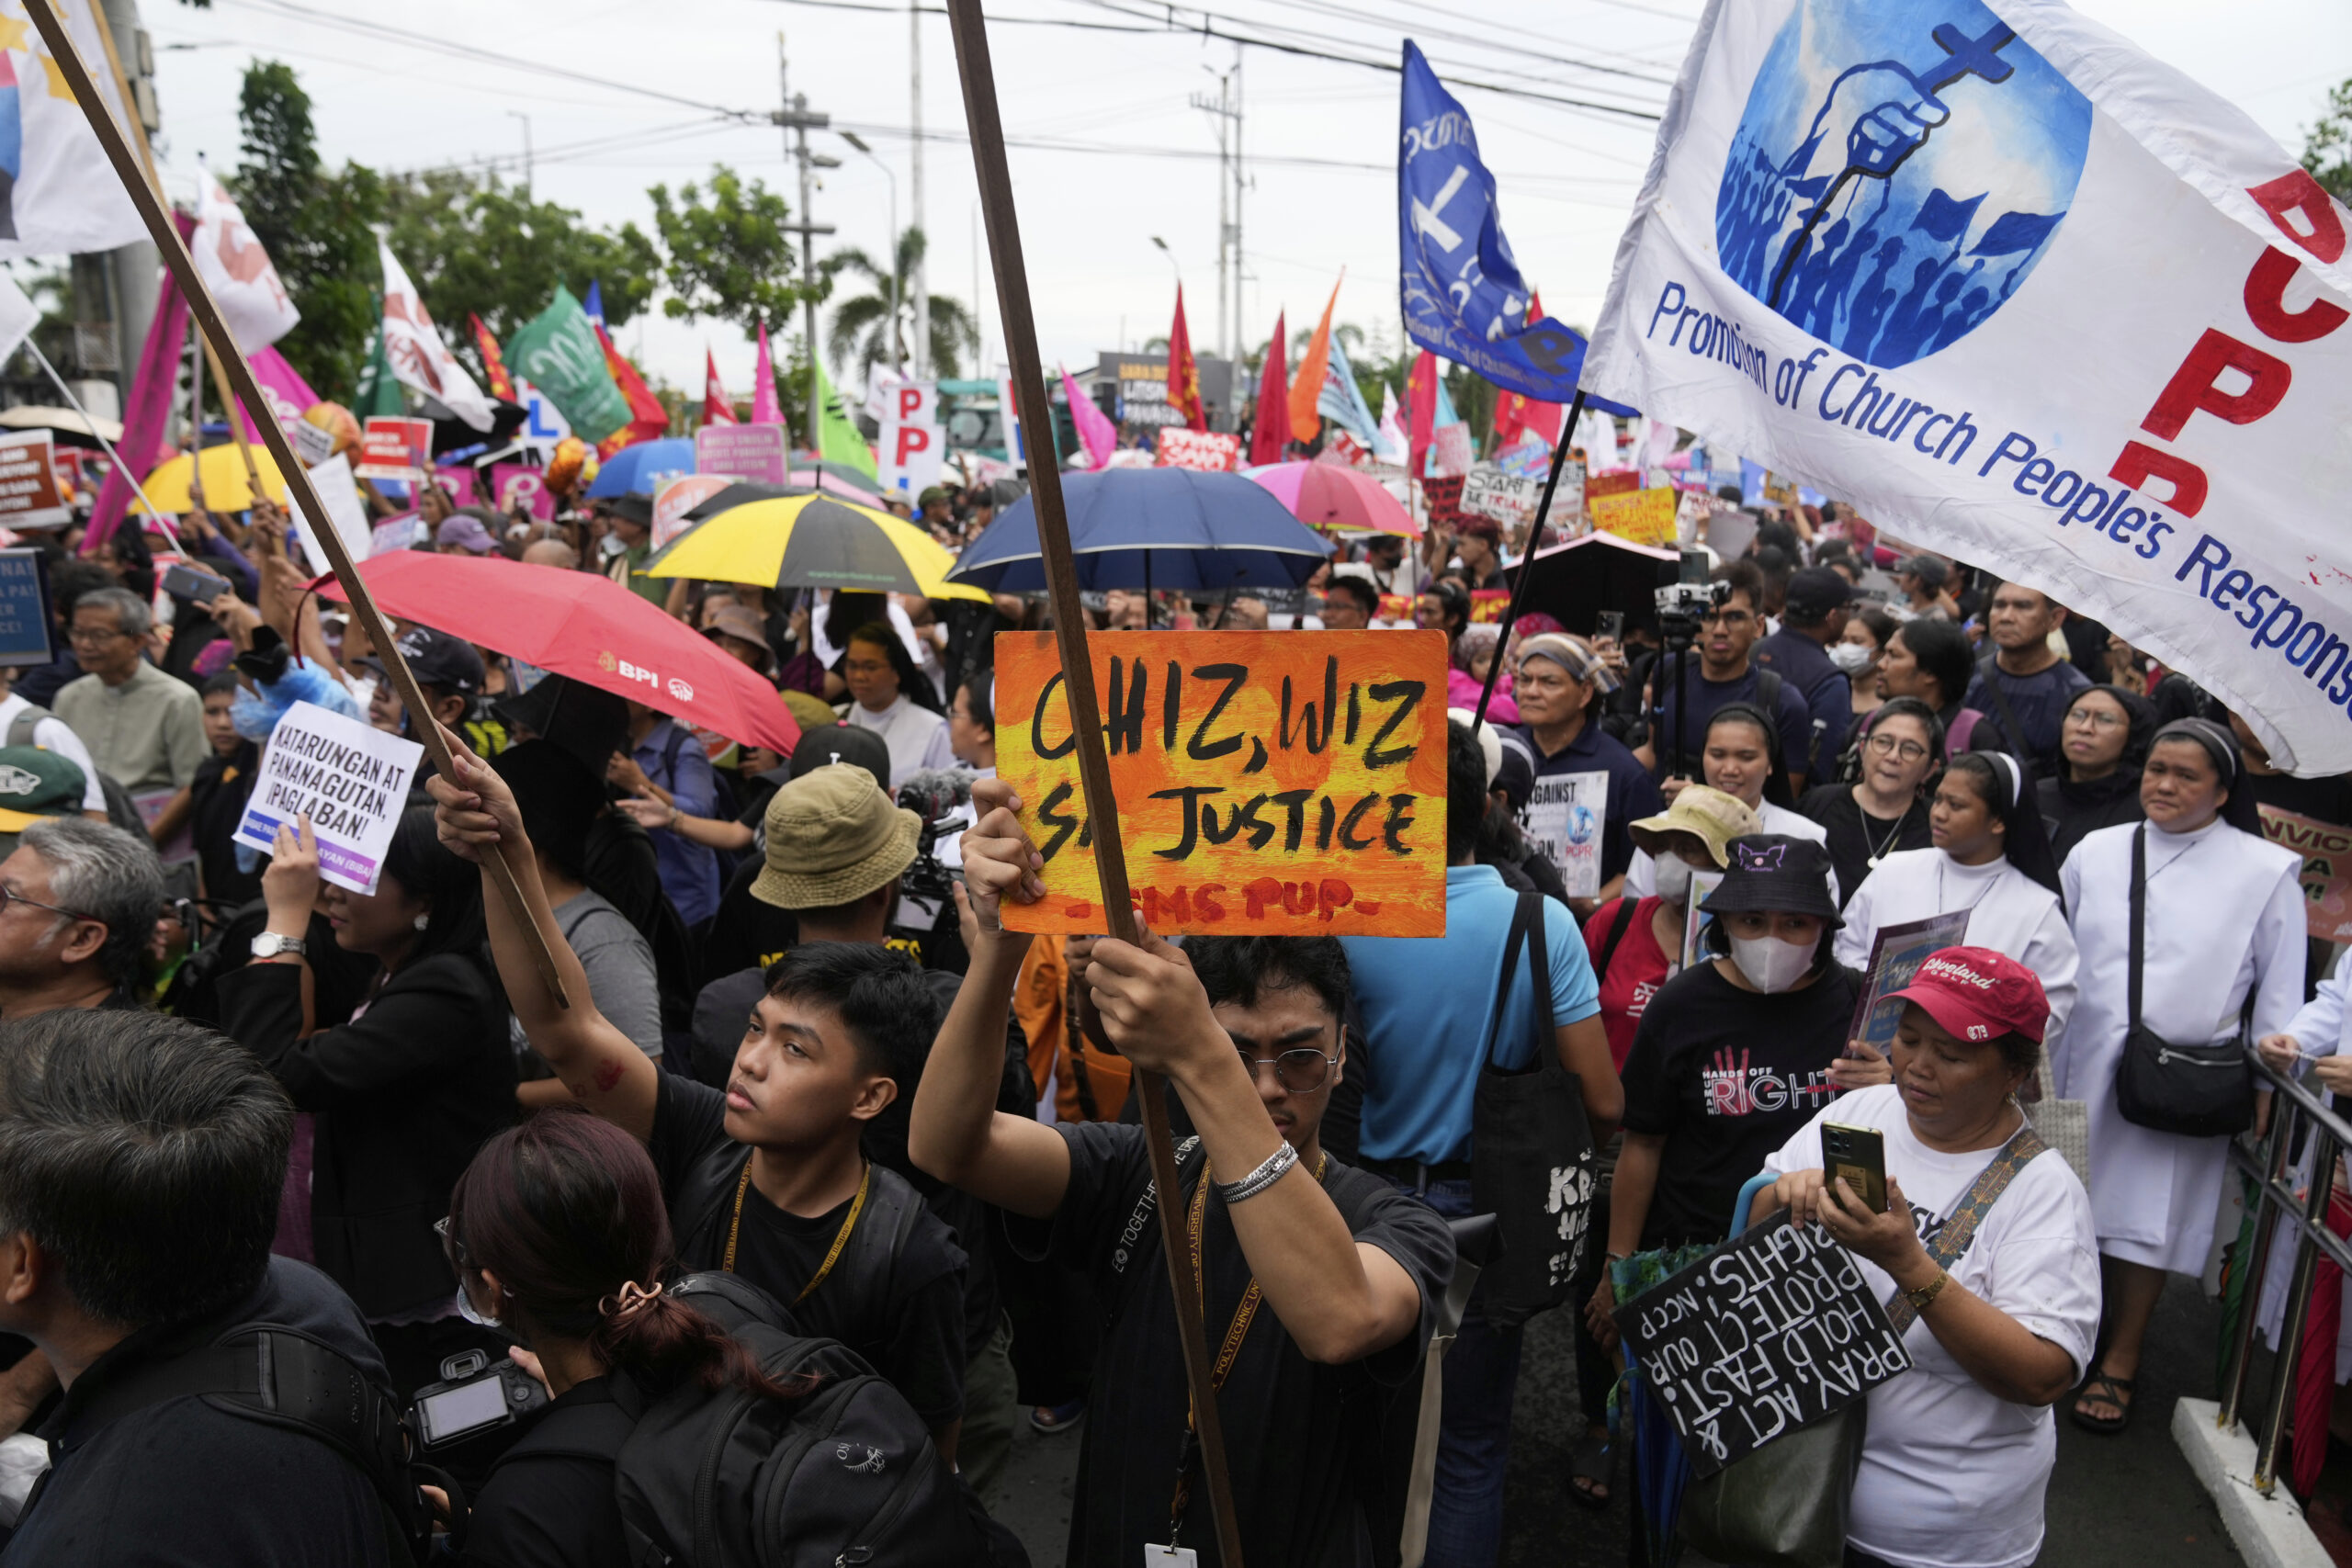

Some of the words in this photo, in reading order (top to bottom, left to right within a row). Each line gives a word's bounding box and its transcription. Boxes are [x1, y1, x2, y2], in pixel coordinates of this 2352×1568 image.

[1647, 281, 1768, 395] Promoion
[1774, 347, 1828, 408] of
[1818, 363, 1977, 465] Church
[1978, 432, 2173, 559] People's
[618, 660, 659, 689] BPI
[1032, 655, 1268, 774] CHIZ,
[1280, 654, 1426, 770] WIZ
[268, 752, 387, 821] PANANAGUTAN,
[275, 725, 383, 784] KATARUNGAN
[383, 764, 404, 792] AT
[266, 783, 369, 841] IPAGLABAN!
[1148, 786, 1419, 861] JUSTICE
[2258, 815, 2351, 852] NVIC
[317, 847, 345, 865] AYAN
[1565, 845, 1593, 858] PCPR
[1242, 876, 1382, 923] PUP-
[1930, 970, 1969, 985] GOLF
[1702, 1069, 1745, 1079] HANDS
[1749, 1066, 1773, 1077] OFF
[725, 1216, 739, 1265] UNIVERSITY
[1120, 1179, 1157, 1247] TOGETHE
[1190, 1188, 1205, 1249] UNIVERSITY
[1694, 1218, 1837, 1319] RIGHTS!
[1216, 1301, 1253, 1375] POLYTECHNIC
[1641, 1287, 1700, 1340] NCCP
[1703, 1245, 1866, 1369] PROTECT
[1782, 1293, 1875, 1368] HOLD
[1641, 1337, 1699, 1385] OUR
[1664, 1340, 1779, 1437] FAST!
[1796, 1330, 1908, 1410] PRAY,
[1695, 1419, 1729, 1461] &
[1738, 1383, 1804, 1449] ACT
